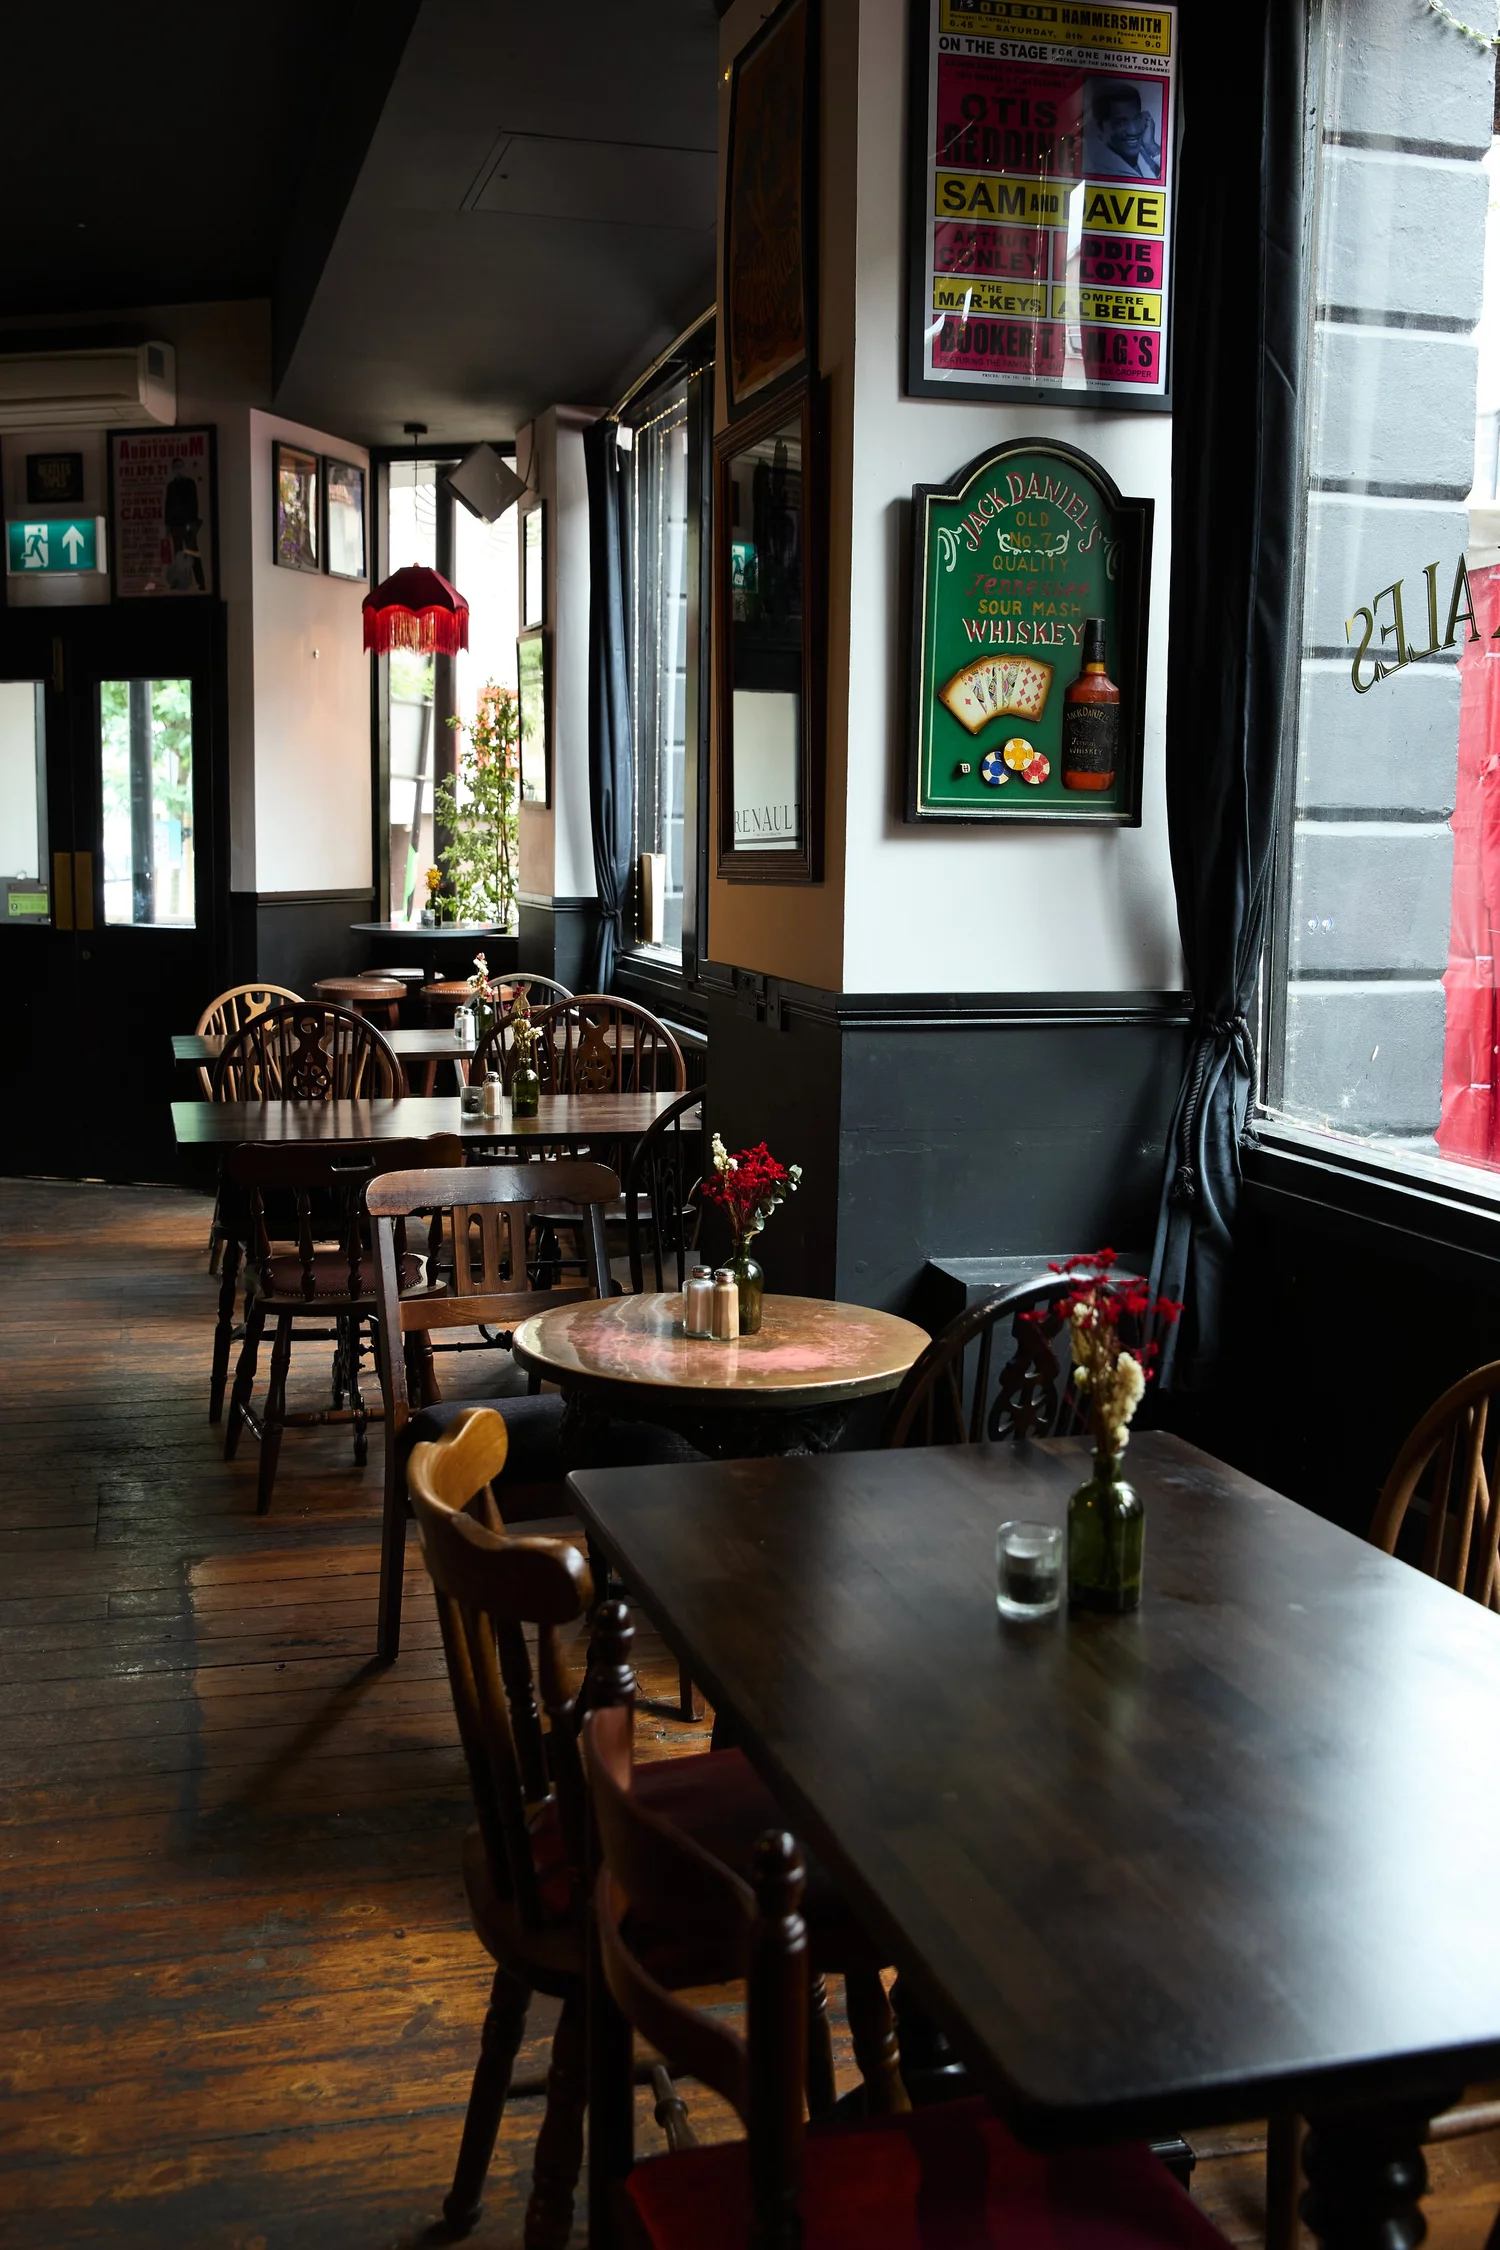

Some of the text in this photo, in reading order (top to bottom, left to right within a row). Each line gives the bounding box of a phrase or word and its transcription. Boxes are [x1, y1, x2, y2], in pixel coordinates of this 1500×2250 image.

[980, 1, 1161, 34] ODEON HAMMERSMITH
[950, 19, 974, 28] 6.45
[996, 24, 1057, 38] SATURDAY,
[1092, 35, 1124, 45] APRIL
[1144, 40, 1161, 49] 9.0
[939, 36, 1170, 67] ON THE STAGE FOR ONE NIGHT ONLY
[961, 94, 1058, 128] OTIS
[943, 123, 1076, 171] REDDING
[943, 180, 1026, 217] SAM
[1030, 194, 1059, 213] AND
[953, 229, 1030, 250] ARTHUR
[1083, 240, 1152, 263] DDIE
[939, 246, 1042, 273] CONLEY
[1078, 259, 1155, 284] LOYD
[980, 284, 1002, 294] THE
[1081, 291, 1144, 306] OMPERE
[939, 291, 1042, 313] MAR-KEYS
[1094, 303, 1156, 323] BELL
[940, 320, 1034, 358] BOOKER
[1041, 328, 1054, 359] T.
[986, 358, 1001, 368] THE
[1115, 368, 1153, 379] CROPPER
[961, 472, 1102, 554] JACK DANIEL'S
[1015, 511, 1050, 527] OLD
[1009, 531, 1053, 549] No. 7
[992, 554, 1070, 573] QUALITY
[978, 599, 1082, 617] SOUR MASH
[962, 618, 1085, 646] WHISKEY
